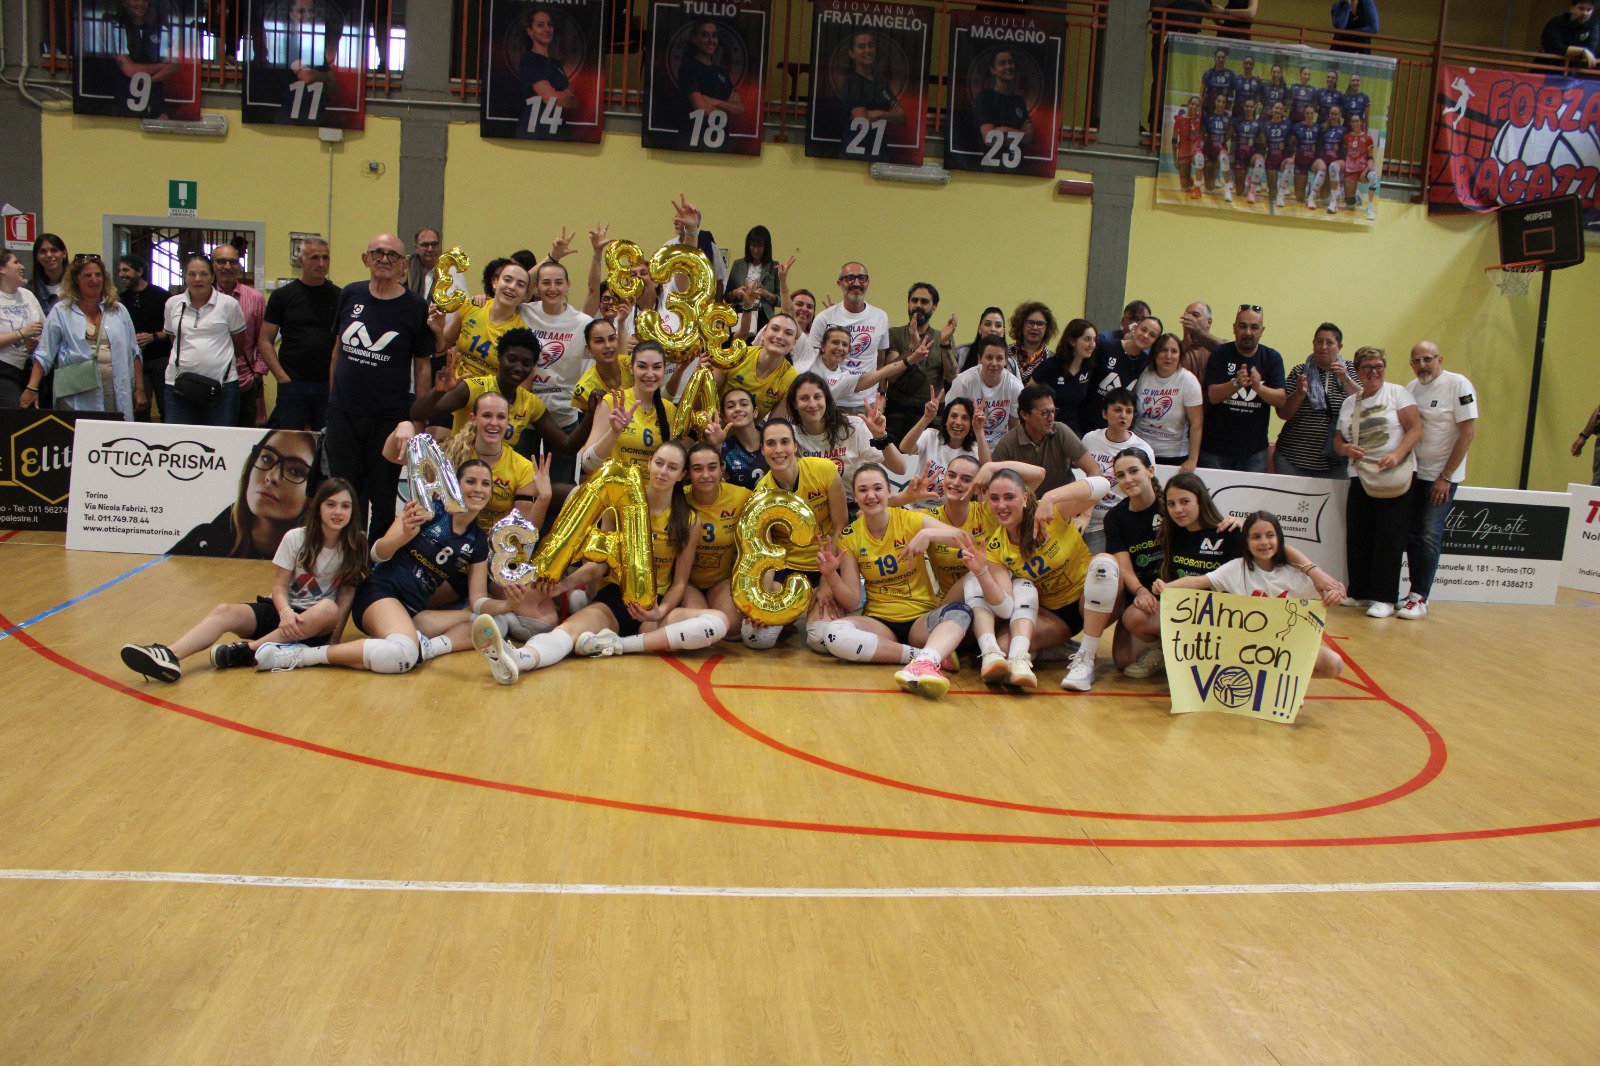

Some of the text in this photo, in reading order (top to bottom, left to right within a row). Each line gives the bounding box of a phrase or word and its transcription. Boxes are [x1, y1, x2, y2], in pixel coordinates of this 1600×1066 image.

[683, 1, 737, 17] TULLIO
[832, 0, 915, 17] GIOVANNA
[823, 10, 922, 31] FRATANGELO
[983, 15, 1036, 28] GIULIA
[970, 25, 1046, 44] MACAGNO
[126, 72, 152, 111] 9
[289, 81, 324, 120] 11
[526, 96, 563, 134] 14
[1489, 79, 1600, 134] FORZA
[689, 109, 728, 148] 18
[846, 117, 887, 156] 21
[981, 130, 1025, 168] 23
[1454, 154, 1600, 210] RAGAZZ
[635, 244, 717, 362] 3
[371, 352, 391, 362] VOLLEY
[469, 335, 492, 359] 14
[643, 427, 653, 447] 6
[88, 449, 227, 471] OTTICA PRISMA
[85, 491, 109, 499] Torino
[13, 505, 26, 513] Tel:
[28, 505, 42, 513] 011
[84, 513, 150, 524] Tel. 011.749.78.44
[97, 503, 121, 511] Nicola
[149, 506, 164, 514] 123
[1274, 514, 1309, 524] ORSARO
[83, 526, 181, 536] www.otticaprismatorino.it
[531, 457, 657, 610] A
[702, 522, 716, 543] 3
[1472, 507, 1526, 541] Ignoti
[435, 546, 454, 565] 8
[1441, 541, 1480, 550] istorante
[1491, 543, 1525, 552] pizzeria
[874, 554, 899, 577] 19
[1022, 555, 1051, 578] 12
[1476, 564, 1489, 572] 181
[1496, 565, 1518, 574] Torino
[1519, 567, 1536, 576] (TO)
[1485, 579, 1499, 587] 011
[1501, 580, 1534, 589] 4386213
[1170, 592, 1269, 633] siAmo
[1172, 630, 1292, 671] tutti con
